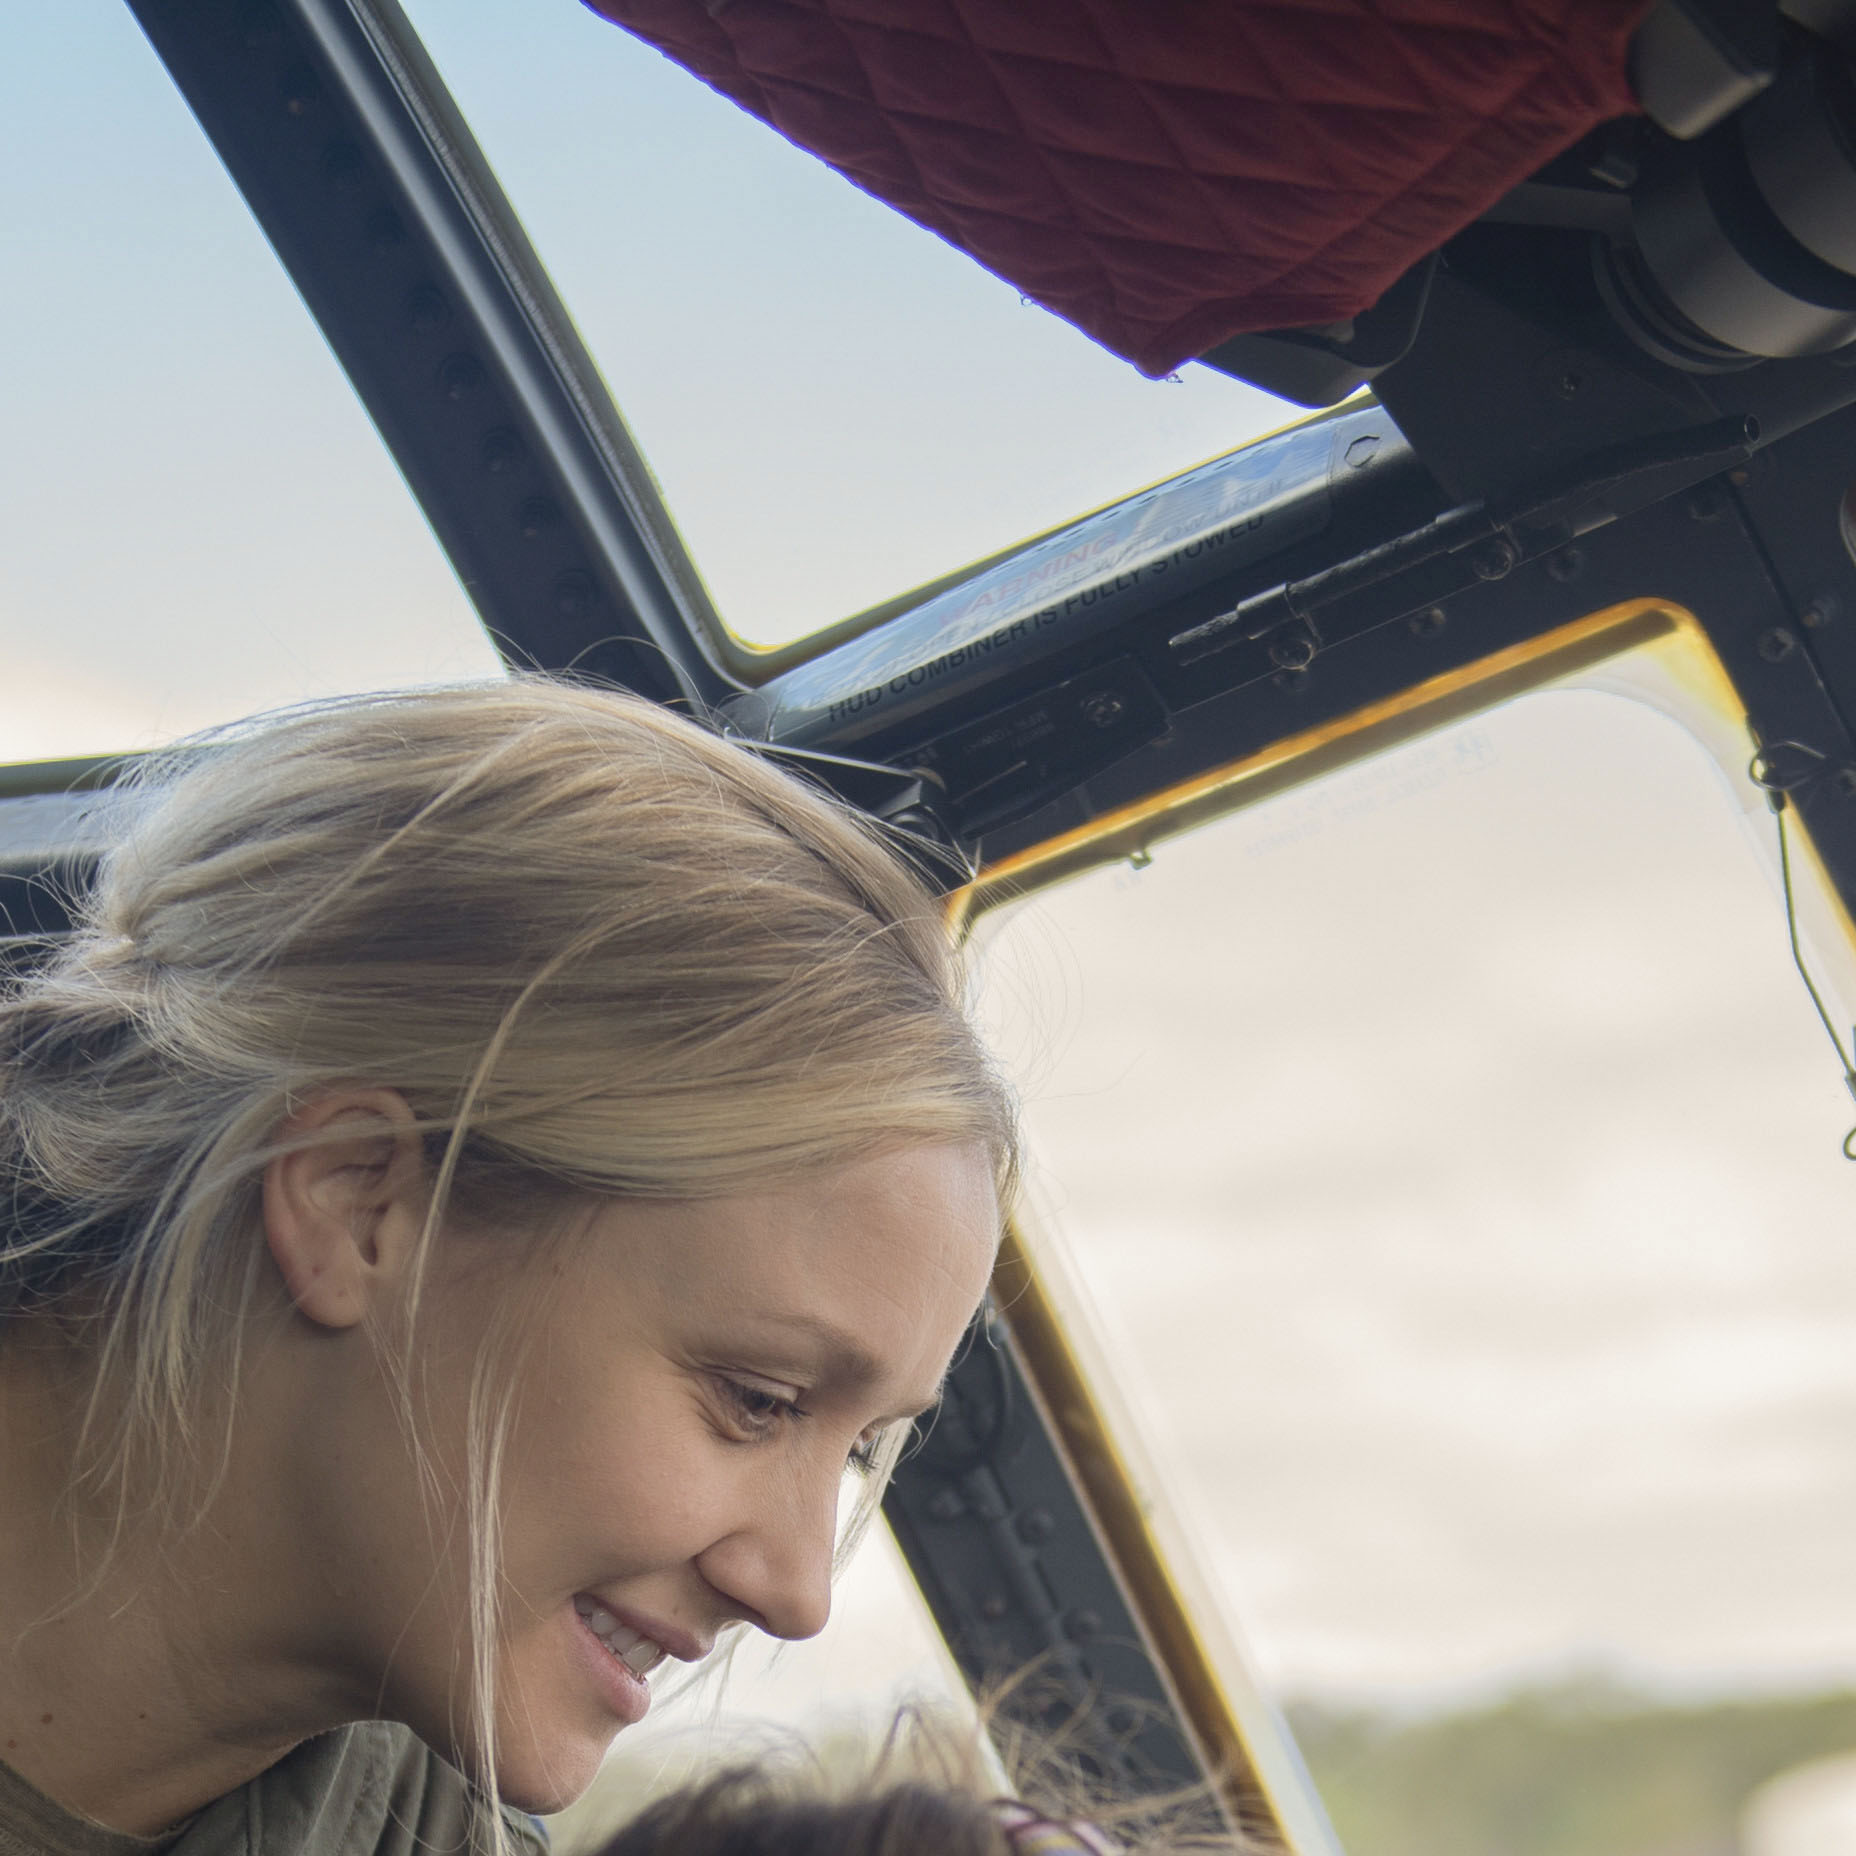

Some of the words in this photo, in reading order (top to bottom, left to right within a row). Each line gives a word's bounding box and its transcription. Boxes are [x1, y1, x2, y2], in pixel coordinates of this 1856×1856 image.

[828, 686, 882, 722] HUD
[889, 619, 1027, 695] COMBINER
[1033, 611, 1057, 630] IS
[1065, 569, 1140, 615] FULLY
[1151, 514, 1264, 575] STOWED
